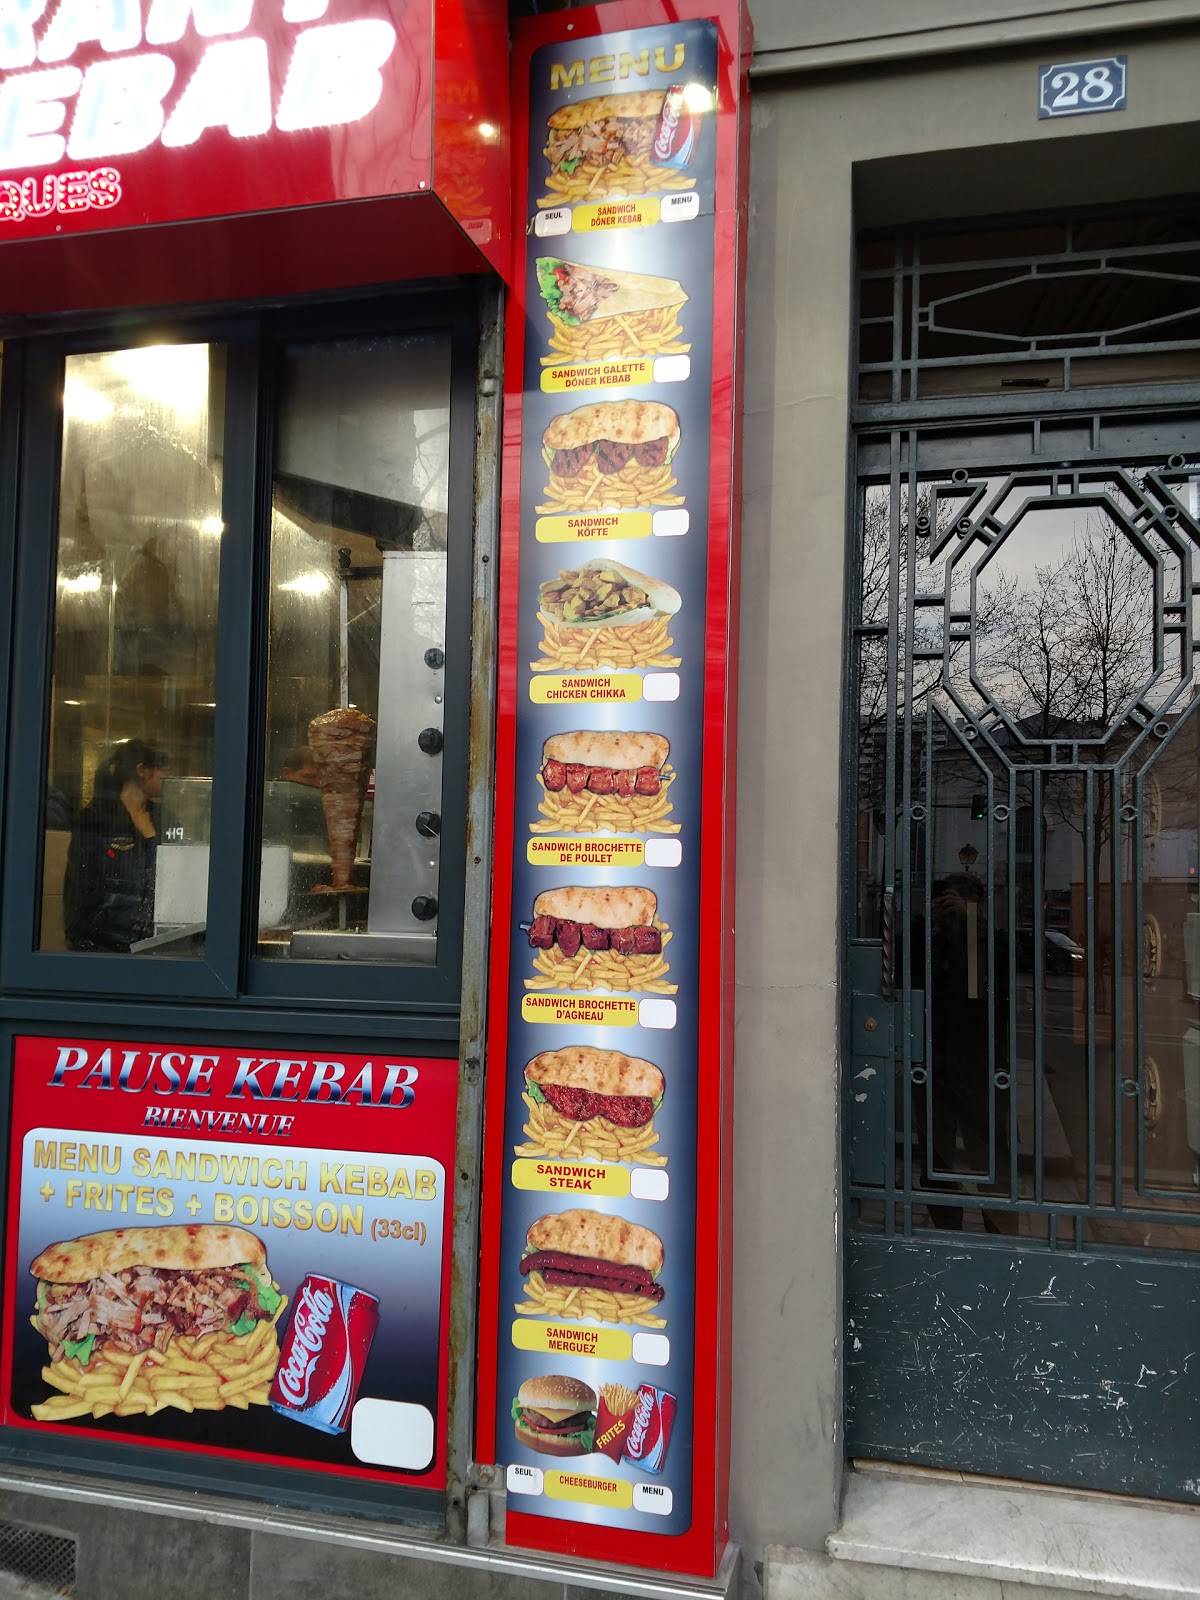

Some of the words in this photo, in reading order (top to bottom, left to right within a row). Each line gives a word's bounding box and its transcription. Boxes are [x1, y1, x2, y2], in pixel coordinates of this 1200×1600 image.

[550, 44, 685, 90] MENU
[1051, 67, 1113, 107] 28
[671, 196, 692, 205] MENU
[597, 204, 636, 216] SANDWICH
[617, 214, 642, 224] KEBAB
[551, 367, 600, 379] SANDWICH
[603, 363, 645, 374] GALETTE
[600, 374, 631, 385] KEBAB
[568, 517, 618, 527] SANDWICH
[577, 527, 608, 537] KÖFTE
[561, 678, 610, 688] SANDWICH
[546, 689, 587, 699] CHICKEN
[590, 689, 626, 698] CHIKKA
[532, 842, 581, 852] SANDWICH
[585, 843, 642, 852] BROCHETTE
[560, 853, 572, 862] DE
[575, 854, 612, 863] POULET
[526, 998, 575, 1008] SANDWICH
[578, 1000, 635, 1011] BROCHETTE
[556, 1010, 603, 1021] D'AGNEAU
[46, 1046, 220, 1096] PAUSE
[225, 1057, 419, 1109] KEBAB
[141, 1105, 295, 1137] BIENVENUE
[33, 1140, 122, 1175] MENU
[132, 1147, 308, 1190] SANDWICH
[319, 1162, 437, 1200] KEBAB
[536, 1165, 606, 1179] SANDWICH
[549, 1178, 592, 1190] STEAK
[66, 1180, 174, 1217] FRITES
[213, 1193, 364, 1235] BOISSON
[371, 1218, 427, 1246] (33cl)
[546, 1328, 598, 1342] SANDWICH
[548, 1340, 596, 1354] MERGUEZ
[596, 1420, 625, 1449] FRITES
[514, 1467, 533, 1477] SEUL
[559, 1475, 617, 1492] CHEESEBURGER
[642, 1486, 664, 1496] MENU
